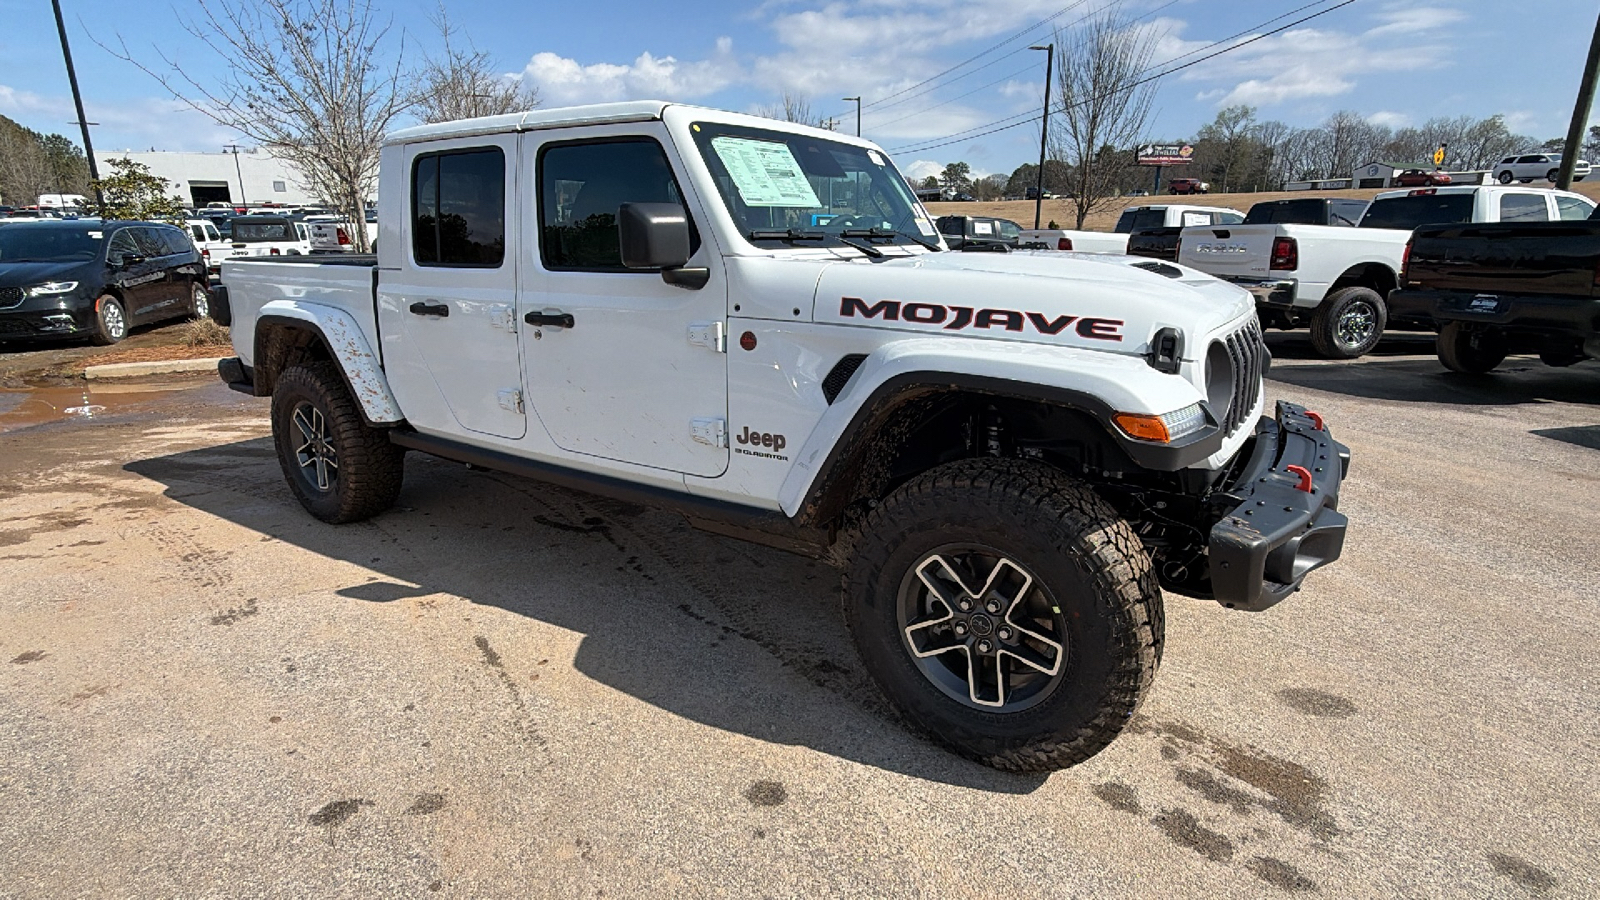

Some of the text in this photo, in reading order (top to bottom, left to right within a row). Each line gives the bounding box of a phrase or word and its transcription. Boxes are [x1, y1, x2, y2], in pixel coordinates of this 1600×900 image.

[1196, 242, 1247, 253] RAM
[840, 296, 1124, 342] MOJAVE
[736, 426, 786, 452] Jeep
[742, 449, 789, 461] GLADIATOR
